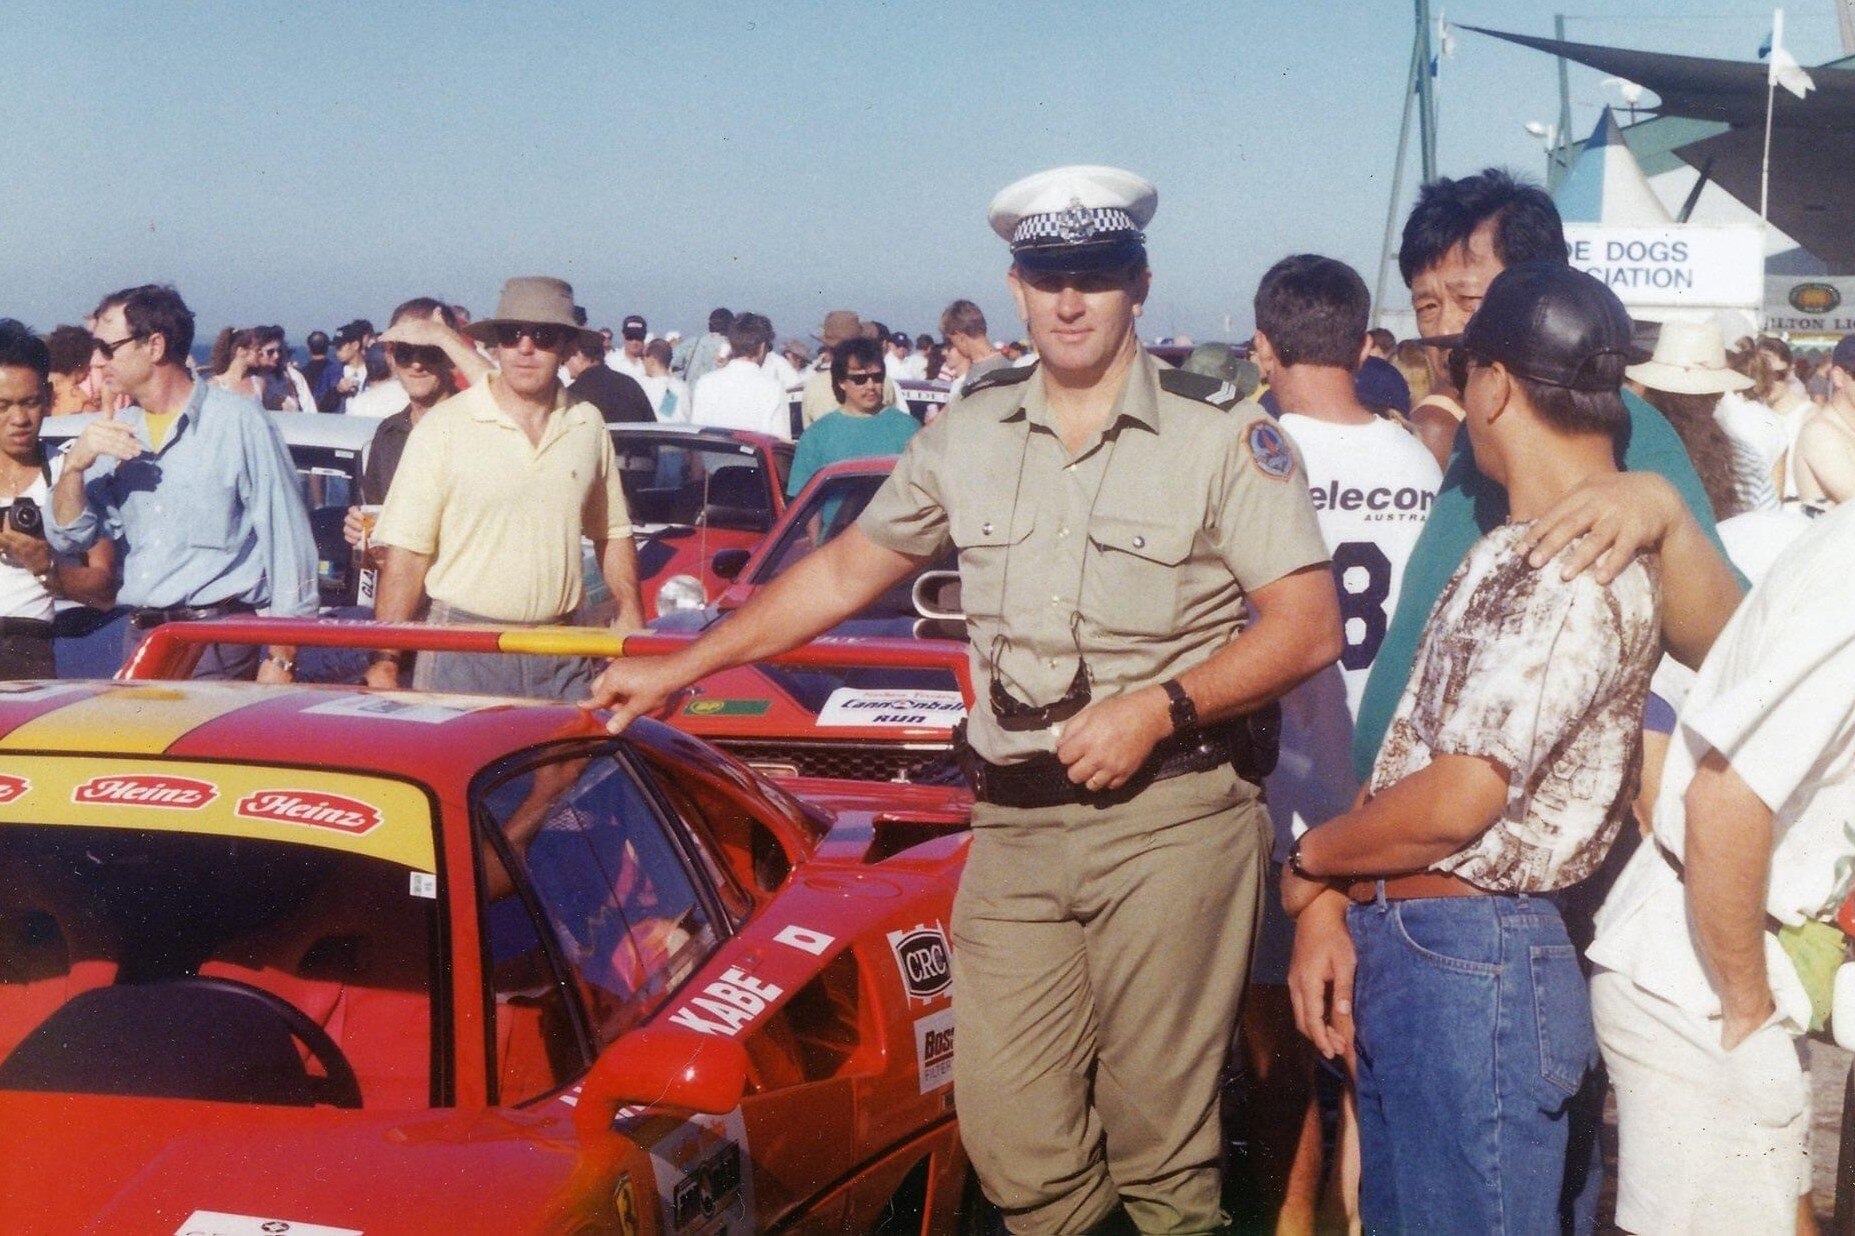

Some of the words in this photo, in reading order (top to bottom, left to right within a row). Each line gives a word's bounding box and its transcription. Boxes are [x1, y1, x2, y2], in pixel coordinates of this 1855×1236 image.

[1606, 241, 1689, 262] DOGS
[1835, 318, 1855, 330] LI
[1309, 480, 1436, 511] eleco
[1332, 541, 1392, 671] 8
[83, 780, 202, 804] Heinz
[246, 795, 366, 827] Heinz
[906, 943, 947, 983] CRC
[668, 967, 784, 1036] KABE
